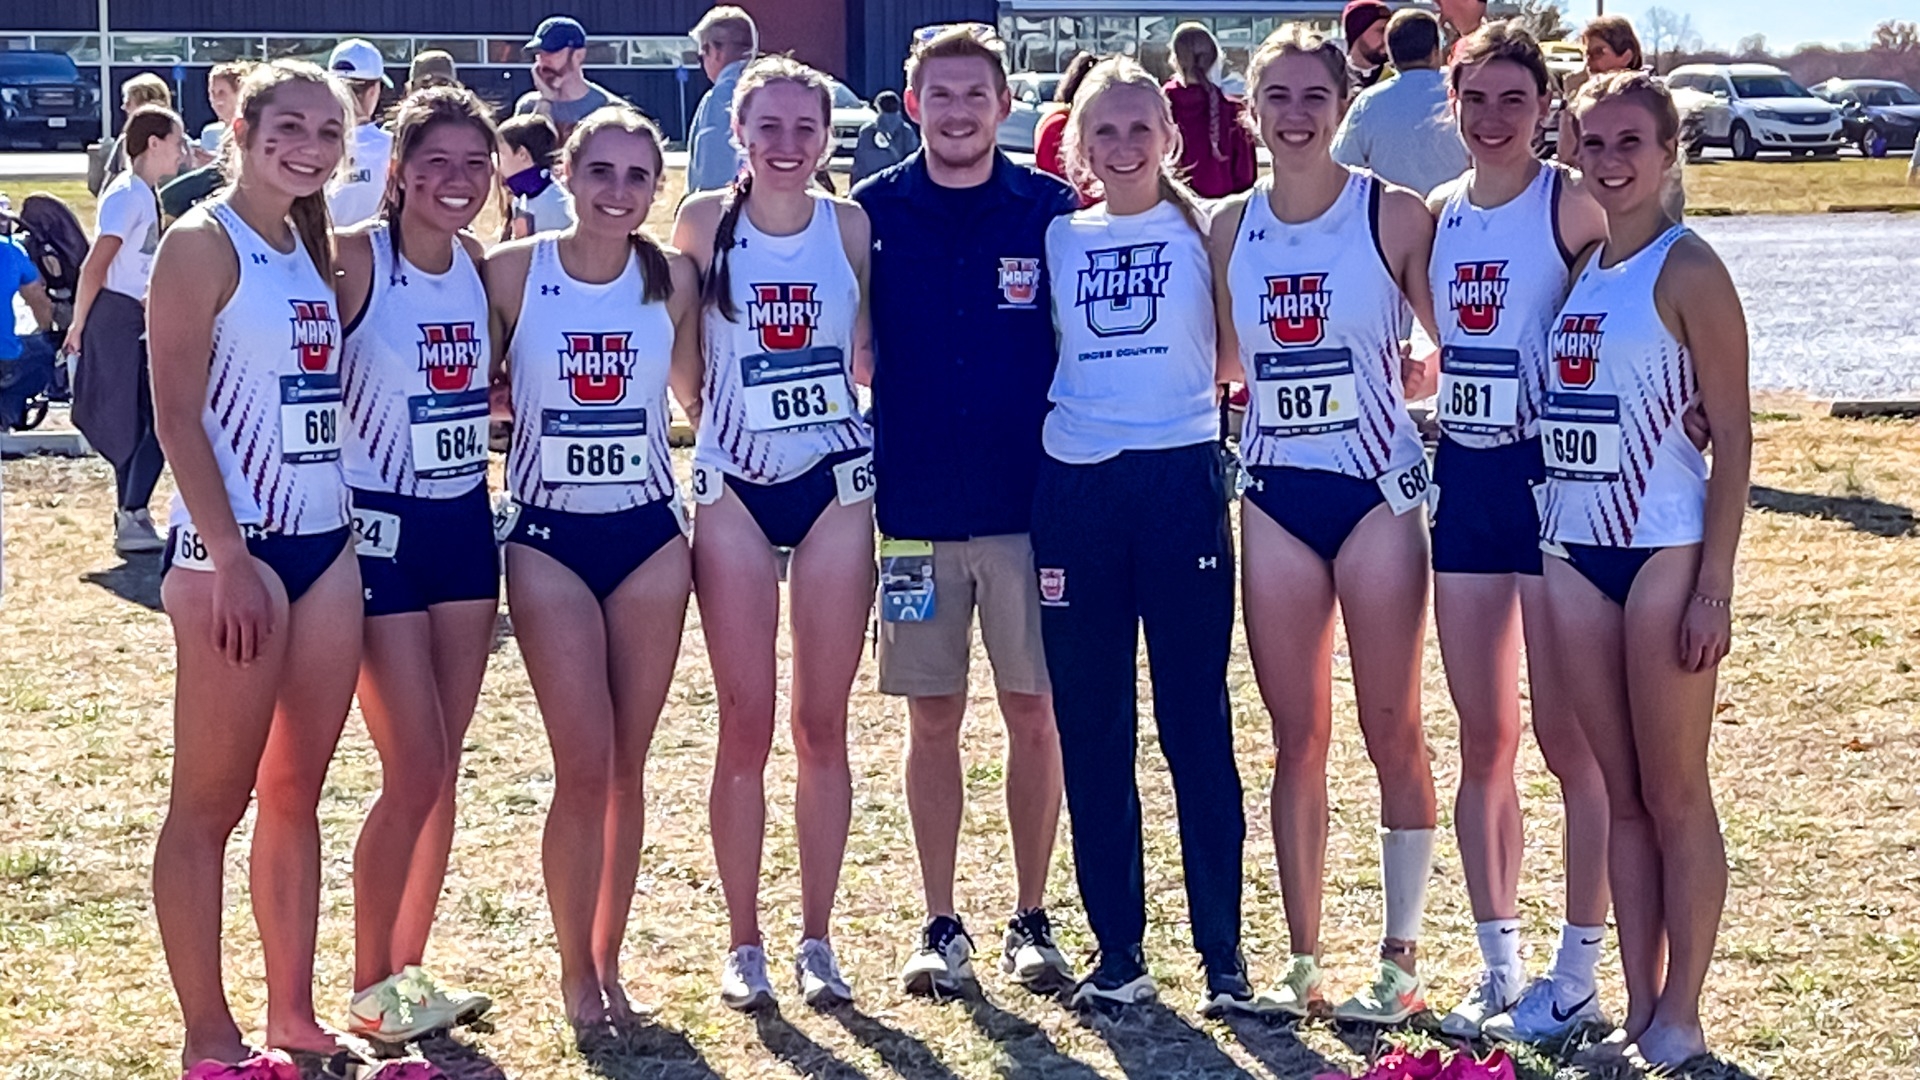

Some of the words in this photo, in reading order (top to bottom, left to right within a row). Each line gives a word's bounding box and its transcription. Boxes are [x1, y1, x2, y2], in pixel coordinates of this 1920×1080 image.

[1002, 269, 1039, 286] MARY
[1078, 263, 1167, 302] MARY
[1263, 293, 1331, 321] MARY
[1451, 279, 1508, 308] MARY
[750, 301, 822, 329] MARY
[292, 318, 337, 349] MARY
[1553, 331, 1602, 359] MARY
[420, 341, 480, 369] MARY
[560, 350, 637, 378] MARY
[772, 383, 828, 421] 683
[1277, 384, 1332, 420] 687
[1452, 382, 1491, 418] 681
[436, 424, 477, 462] 684
[1553, 427, 1597, 465] 690
[566, 443, 625, 477] 686
